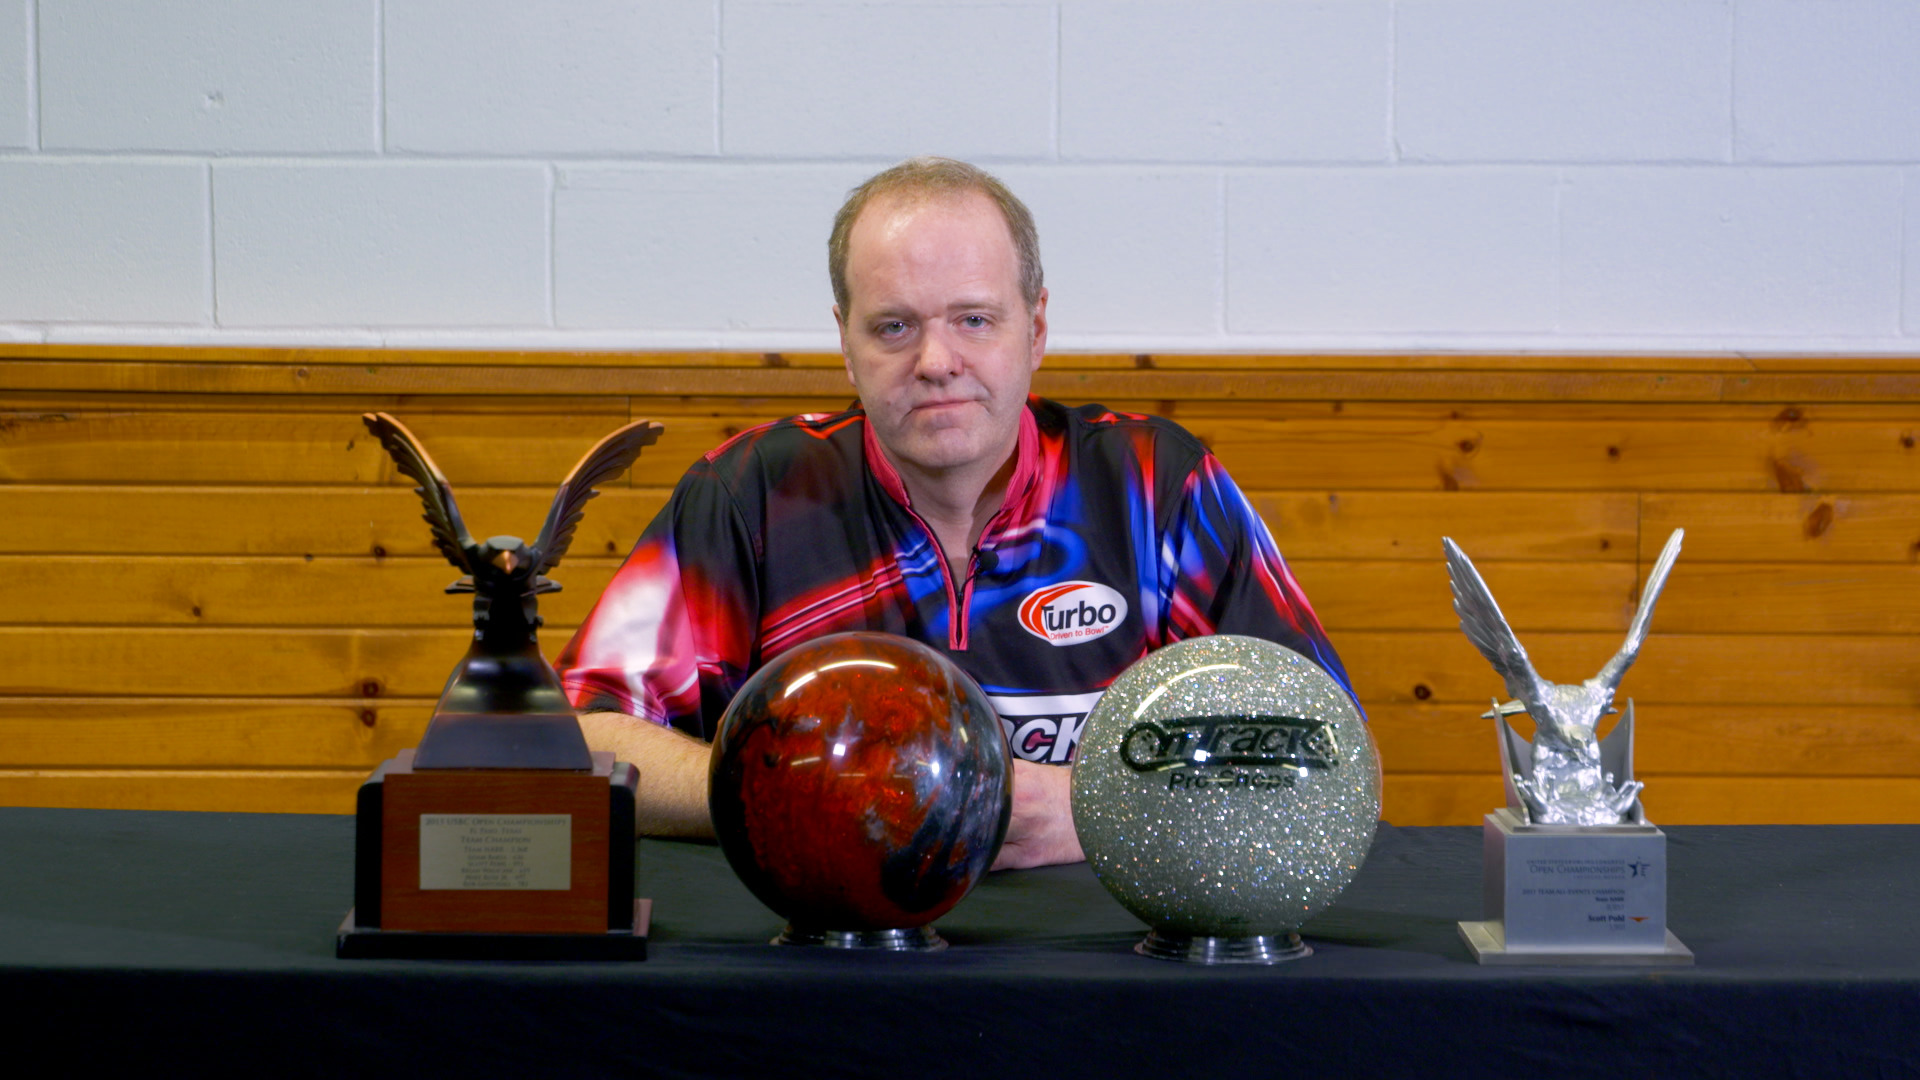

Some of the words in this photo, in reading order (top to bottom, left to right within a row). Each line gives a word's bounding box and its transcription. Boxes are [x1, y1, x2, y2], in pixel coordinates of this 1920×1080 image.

[1041, 600, 1116, 631] Turbo
[1050, 631, 1073, 640] Driven
[1169, 772, 1209, 790] Pro
[1218, 769, 1295, 790] Shops
[1588, 914, 1607, 922] Scott
